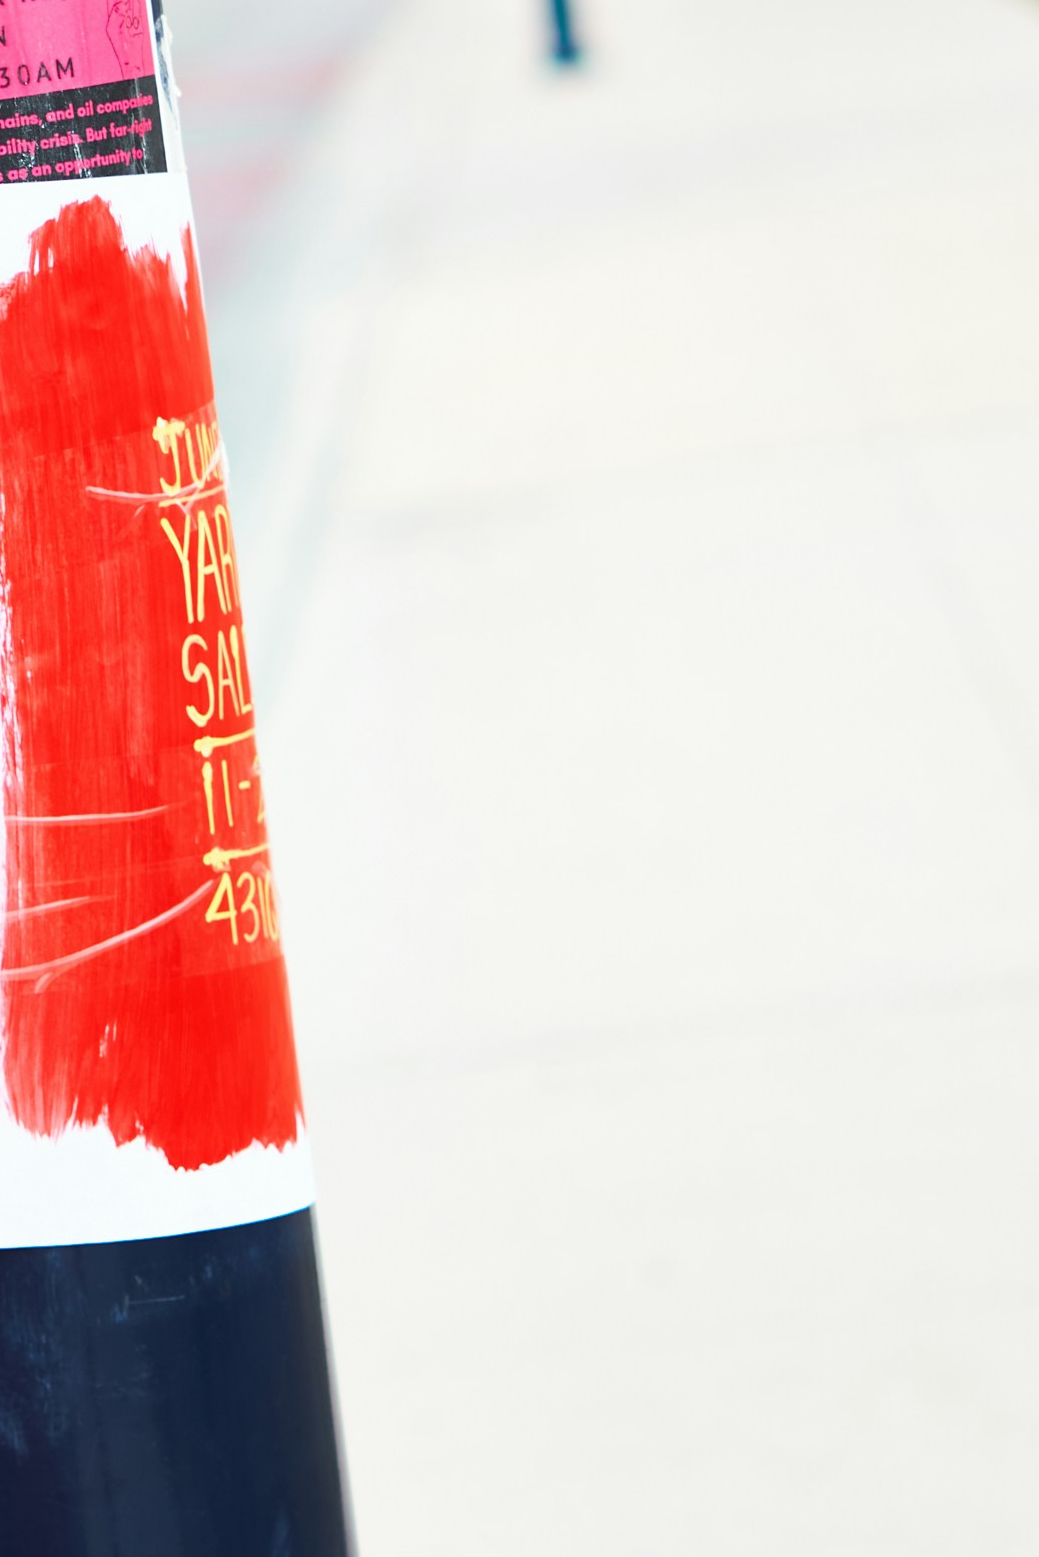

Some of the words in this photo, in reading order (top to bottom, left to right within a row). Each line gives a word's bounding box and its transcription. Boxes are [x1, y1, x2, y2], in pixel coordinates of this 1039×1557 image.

[46, 103, 74, 122] and
[77, 100, 94, 117] oil
[85, 127, 107, 142] But
[110, 117, 152, 137] far-right
[7, 168, 28, 181] as
[31, 164, 51, 177] an
[55, 149, 131, 176] opportunity
[132, 147, 143, 160] to
[181, 624, 253, 727] SAL
